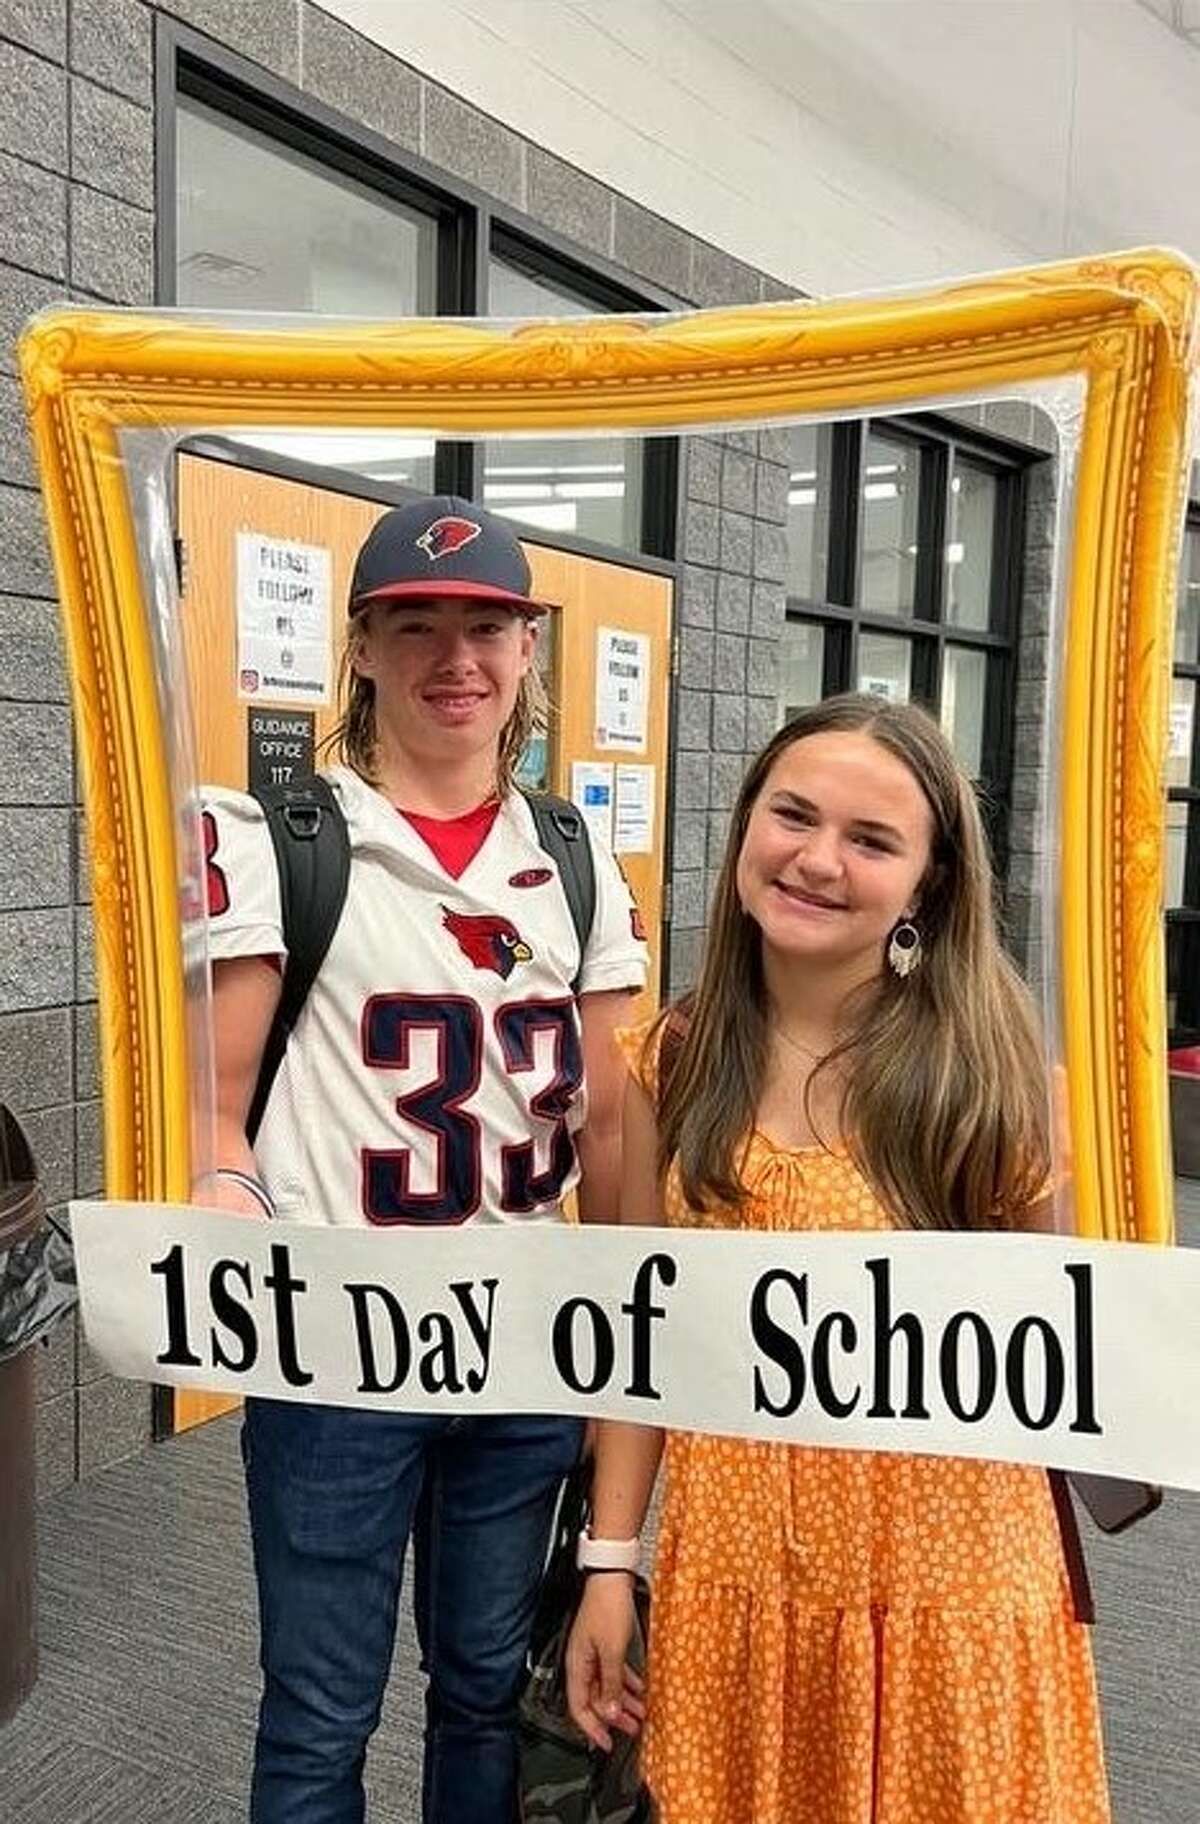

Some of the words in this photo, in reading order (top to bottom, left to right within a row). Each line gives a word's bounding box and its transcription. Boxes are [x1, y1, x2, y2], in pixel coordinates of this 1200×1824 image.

[257, 579, 313, 605] FOLLOW
[253, 718, 311, 738] GUIDANCE
[260, 741, 303, 758] OFFICE
[270, 766, 293, 784] 117
[361, 993, 584, 1226] 33
[150, 1243, 315, 1388] 1st
[343, 1277, 500, 1395] Day
[552, 1252, 678, 1402] of
[749, 1257, 1103, 1436] School
